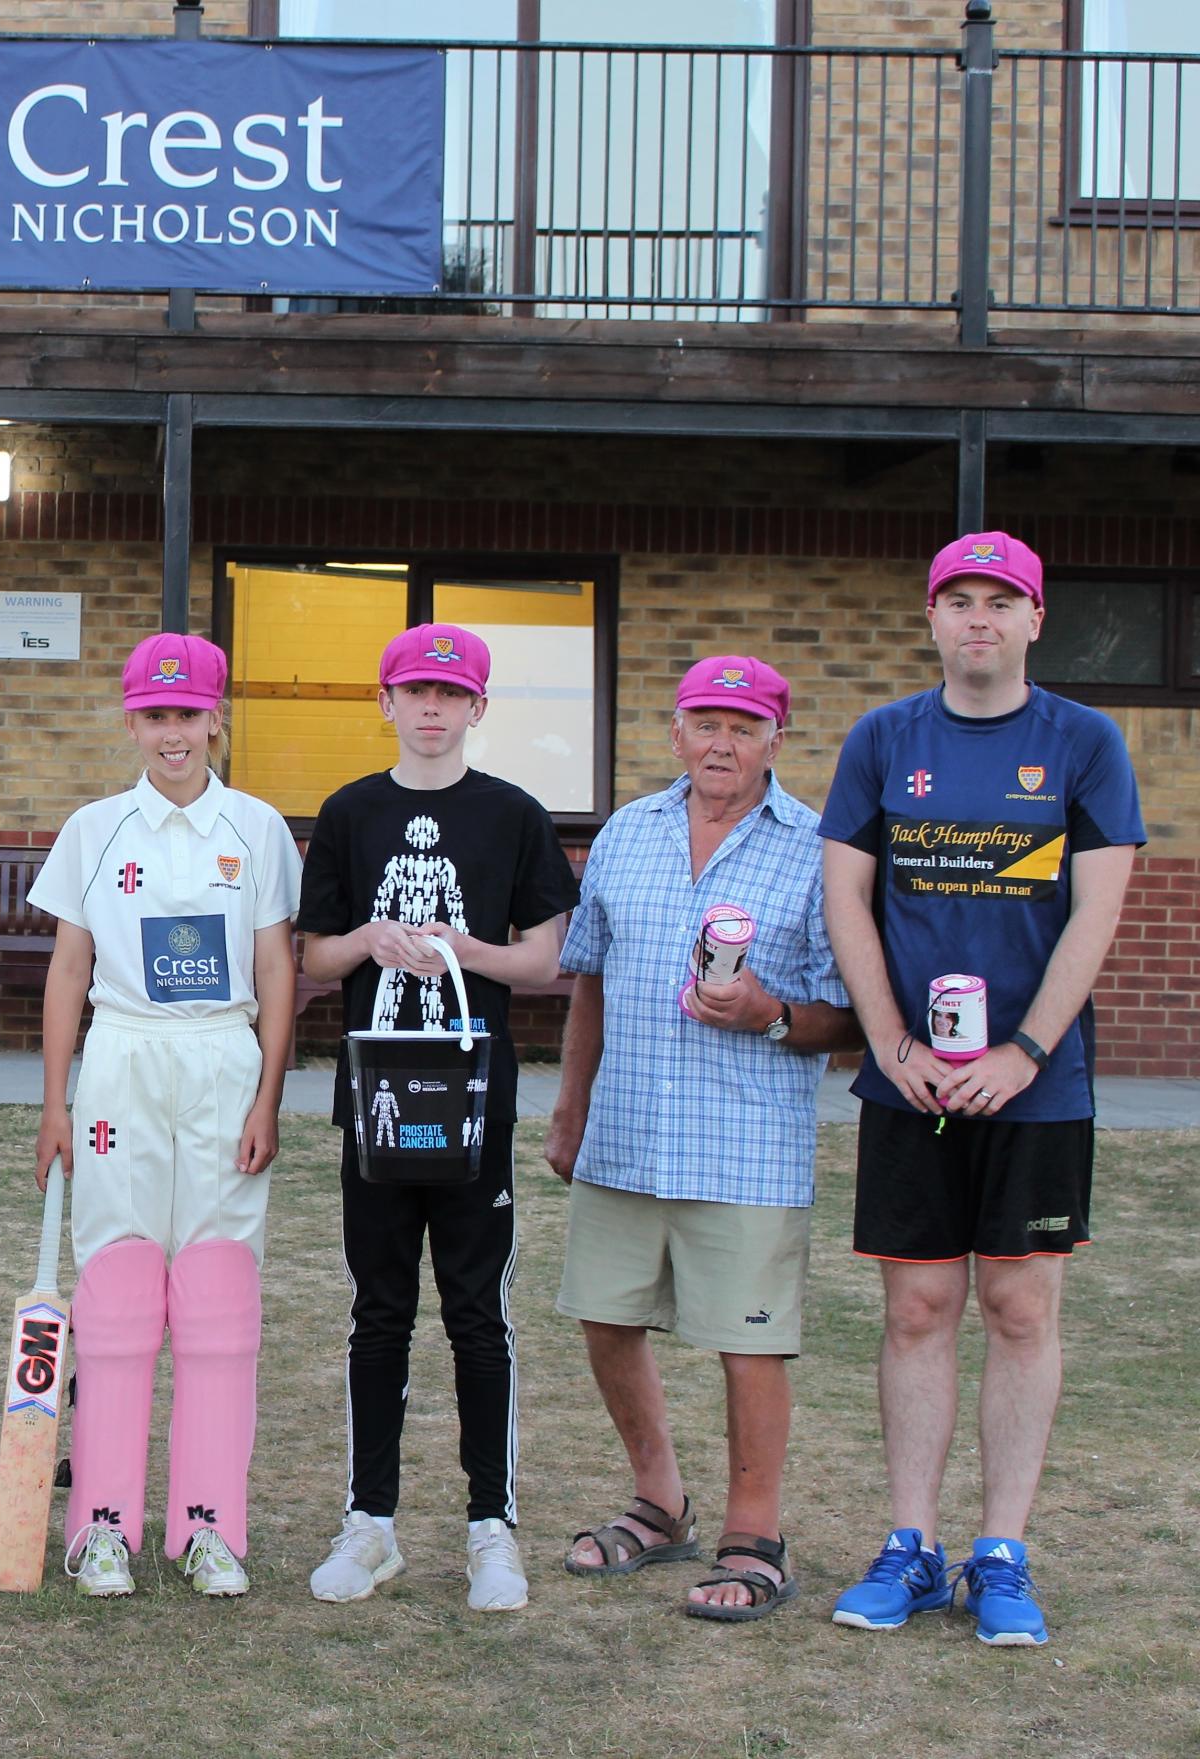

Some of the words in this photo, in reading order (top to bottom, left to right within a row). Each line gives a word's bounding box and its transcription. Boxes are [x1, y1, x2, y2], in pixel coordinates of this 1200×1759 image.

[7, 84, 343, 193] Crest
[10, 202, 341, 248] NICHOLSON
[4, 596, 63, 608] WARNING
[1005, 793, 1046, 801] CHIPPENHAM
[890, 822, 934, 849] Jack
[931, 824, 1033, 854] Humphrys
[893, 854, 936, 867] General
[939, 856, 994, 869] Builders
[911, 878, 934, 891] The
[937, 880, 968, 894] open
[972, 881, 1001, 895] plan
[1005, 885, 1032, 896] man
[153, 955, 219, 976] Crest
[156, 976, 219, 988] NICHOLSON
[450, 1018, 486, 1030] PROTATE
[400, 1124, 443, 1137] PROSTATE
[400, 1136, 434, 1148] CANCER
[435, 1136, 447, 1148] UK
[492, 1198, 512, 1208] adidas
[745, 1316, 767, 1324] PUMA
[17, 1319, 60, 1395] GM
[92, 1507, 121, 1524] MC
[187, 1504, 217, 1523] MC
